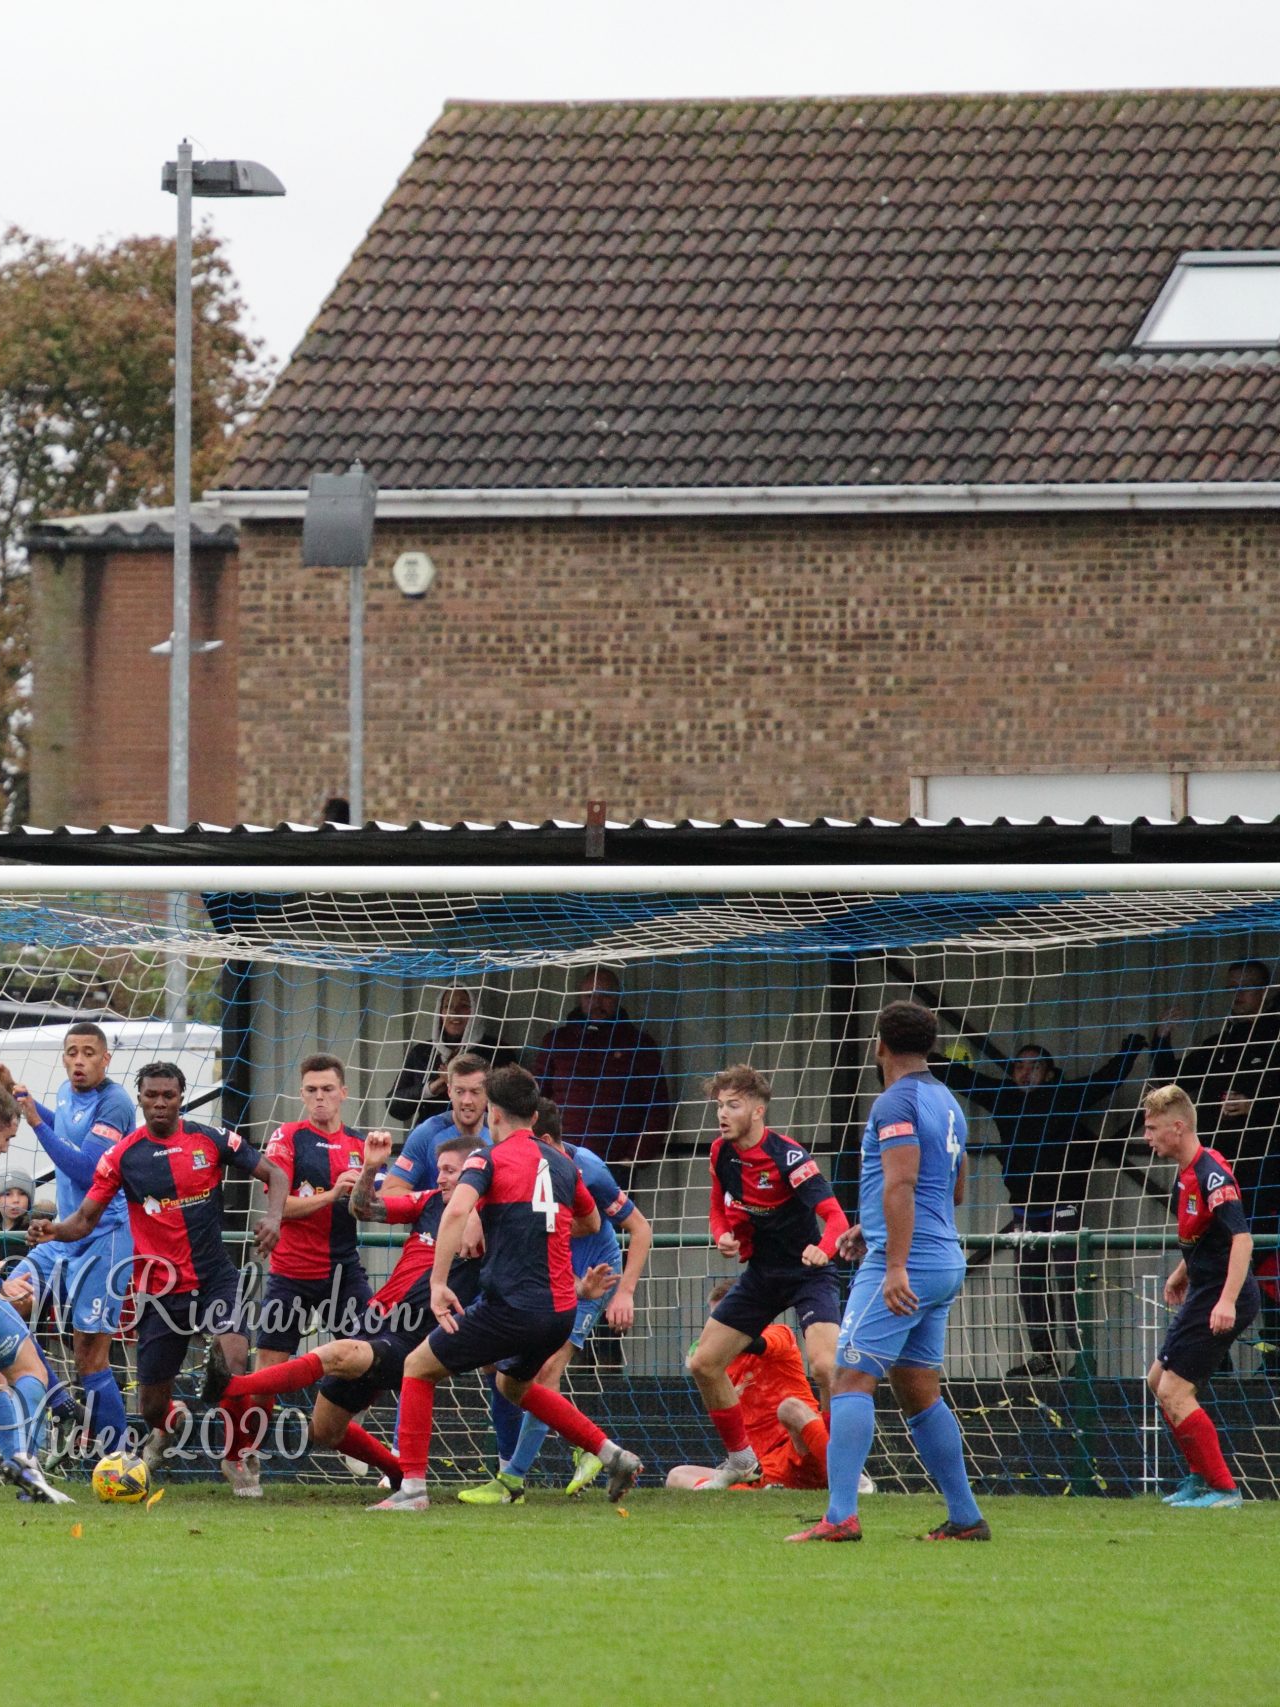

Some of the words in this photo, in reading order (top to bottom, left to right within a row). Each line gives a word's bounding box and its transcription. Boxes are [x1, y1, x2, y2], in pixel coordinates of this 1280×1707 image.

[946, 1109, 961, 1172] 4
[532, 1158, 559, 1233] 4
[92, 1298, 102, 1315] 9
